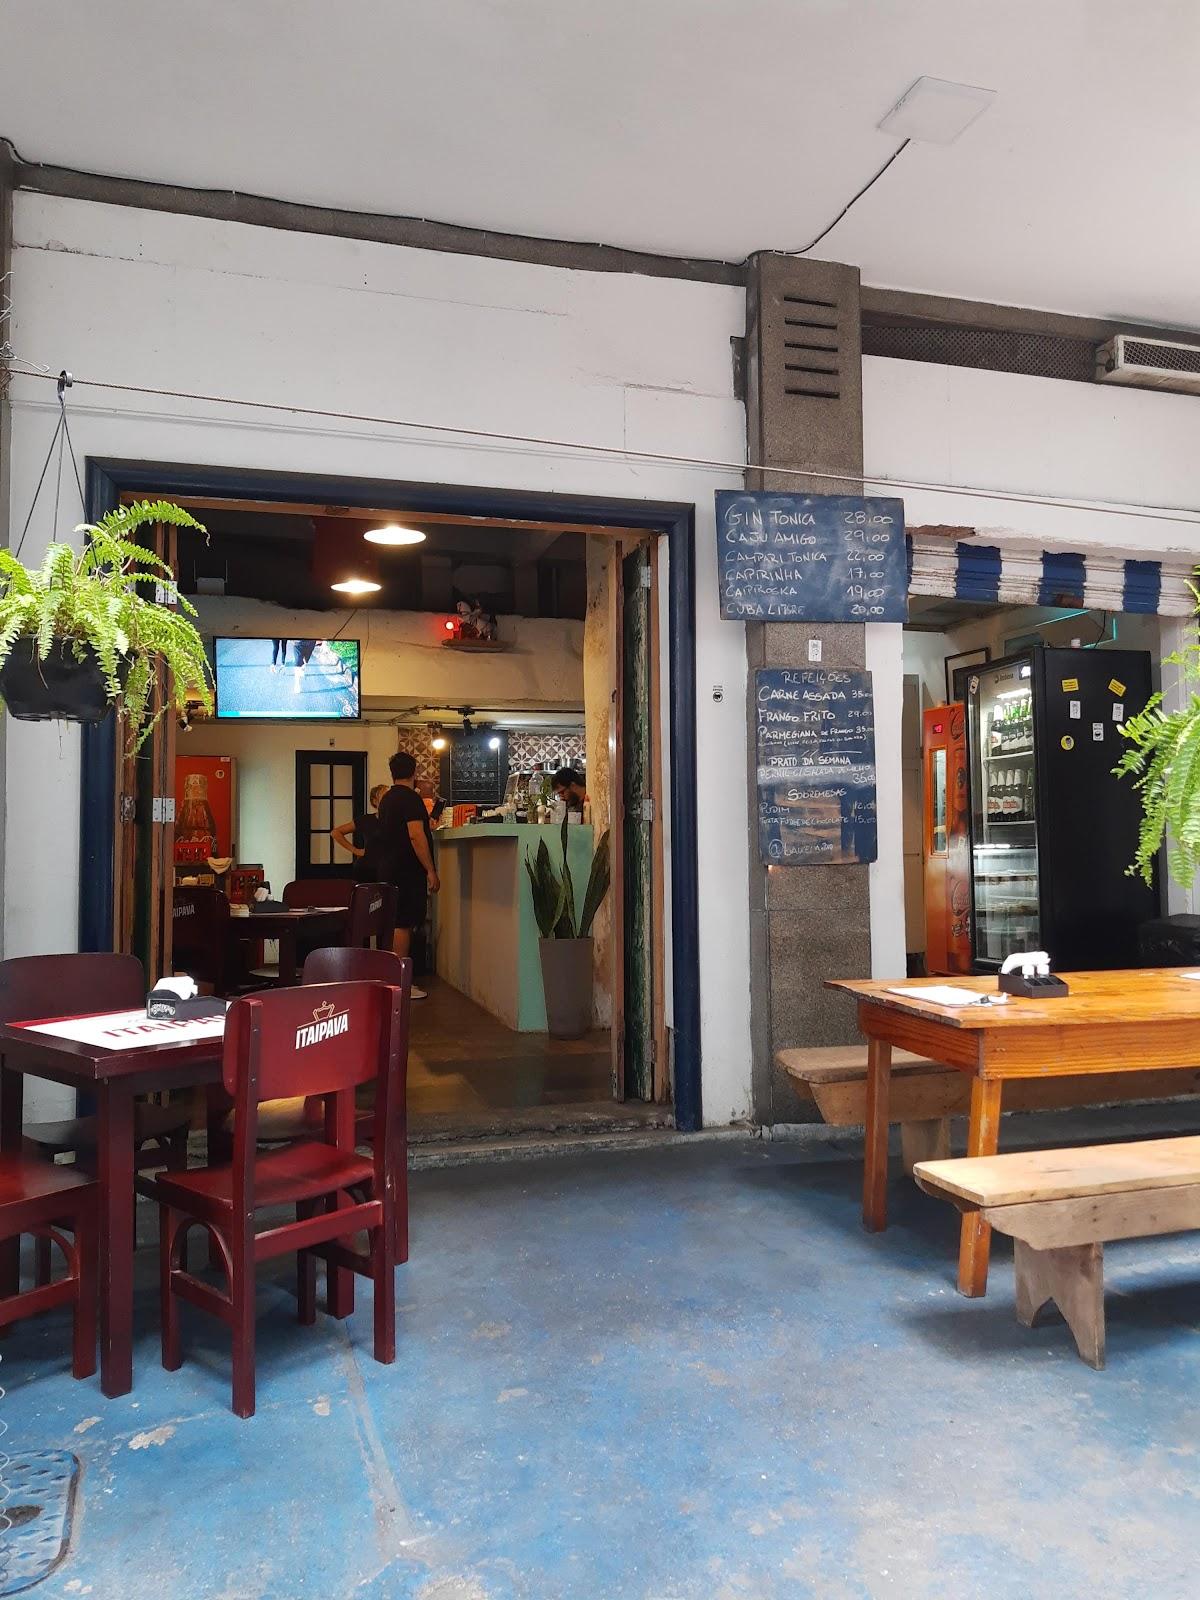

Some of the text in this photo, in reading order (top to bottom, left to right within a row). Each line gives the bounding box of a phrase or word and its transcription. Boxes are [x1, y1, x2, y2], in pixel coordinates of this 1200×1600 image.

[724, 503, 763, 525] GIN
[770, 510, 816, 525] TONICA
[725, 528, 768, 543] CAJU
[774, 532, 817, 545] AMIGO
[726, 550, 784, 564] CAMPARI
[788, 552, 827, 562] TONICA
[726, 602, 764, 616] CUBA
[768, 603, 806, 616] LIBRE
[758, 686, 800, 701] CARNE
[803, 690, 846, 701] ASSADA
[758, 708, 800, 722] FRANGO
[769, 756, 852, 767] PRATO DA SEMANA
[787, 788, 847, 800] SOBREMESAS
[759, 802, 790, 814] PUDIM
[295, 1013, 349, 1050] ITAIPAVA
